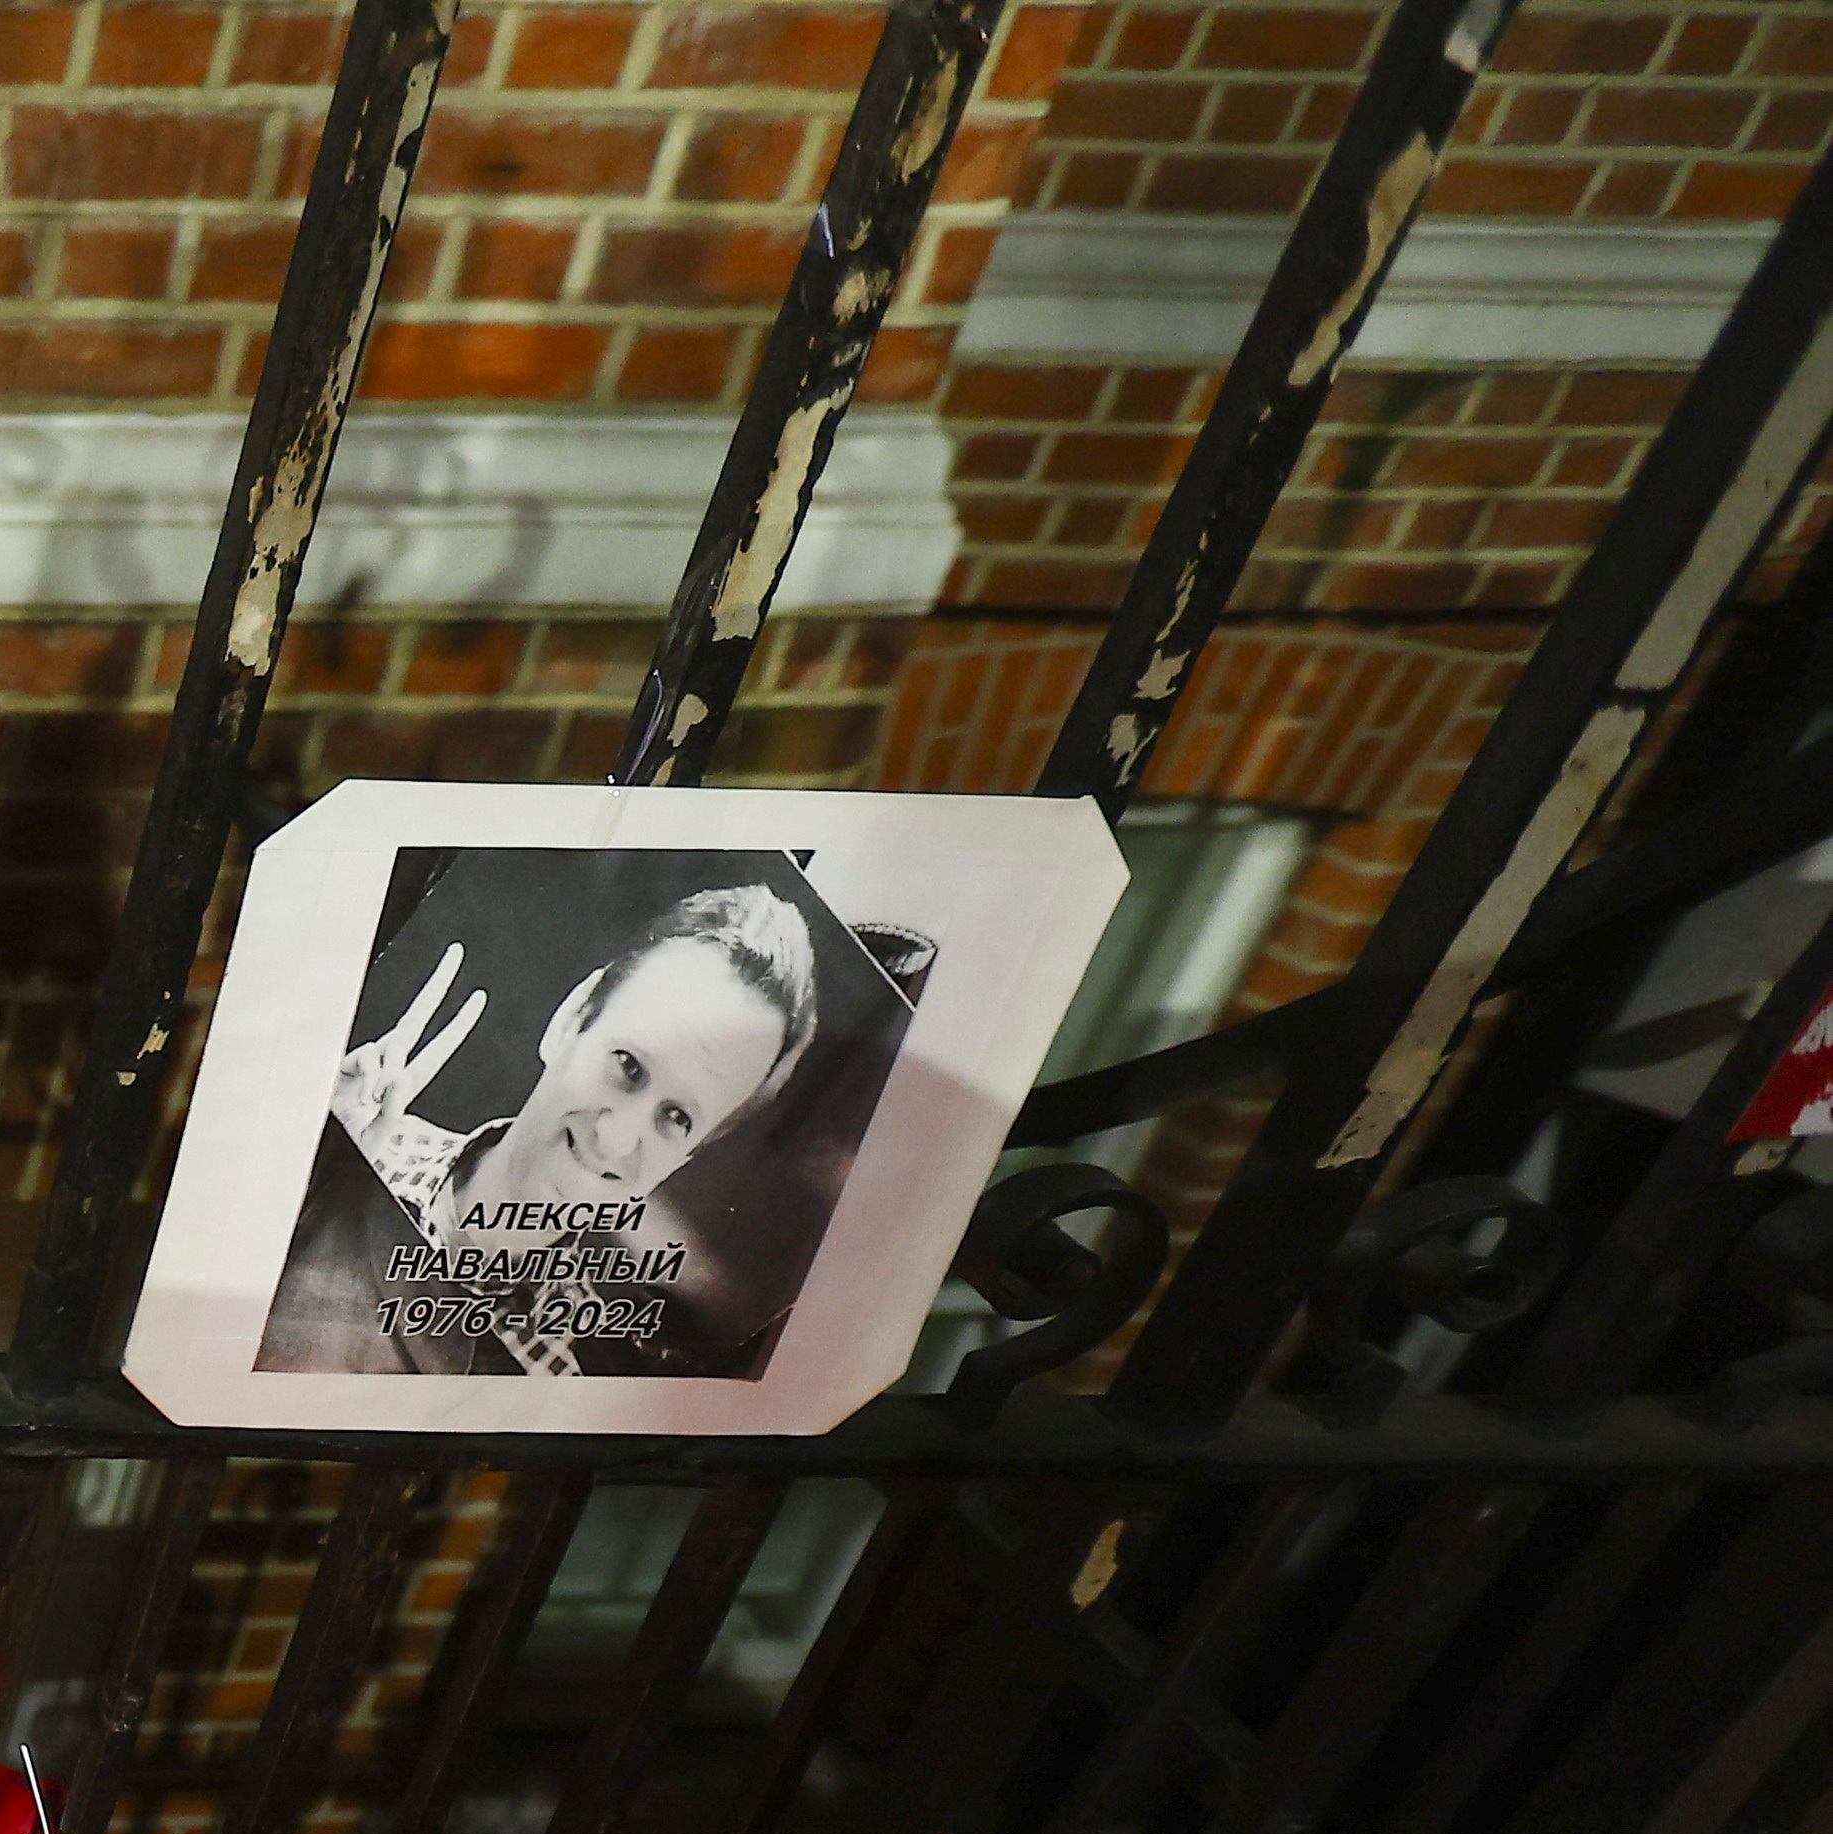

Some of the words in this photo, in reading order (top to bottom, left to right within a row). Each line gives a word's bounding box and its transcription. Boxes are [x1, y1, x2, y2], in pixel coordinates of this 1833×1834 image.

[458, 1195, 646, 1232] АЛЕКСЕЙ
[384, 1240, 687, 1283] НАВАЛЬНЫЙ
[376, 1298, 496, 1338] 1976
[538, 1298, 666, 1339] 2024
